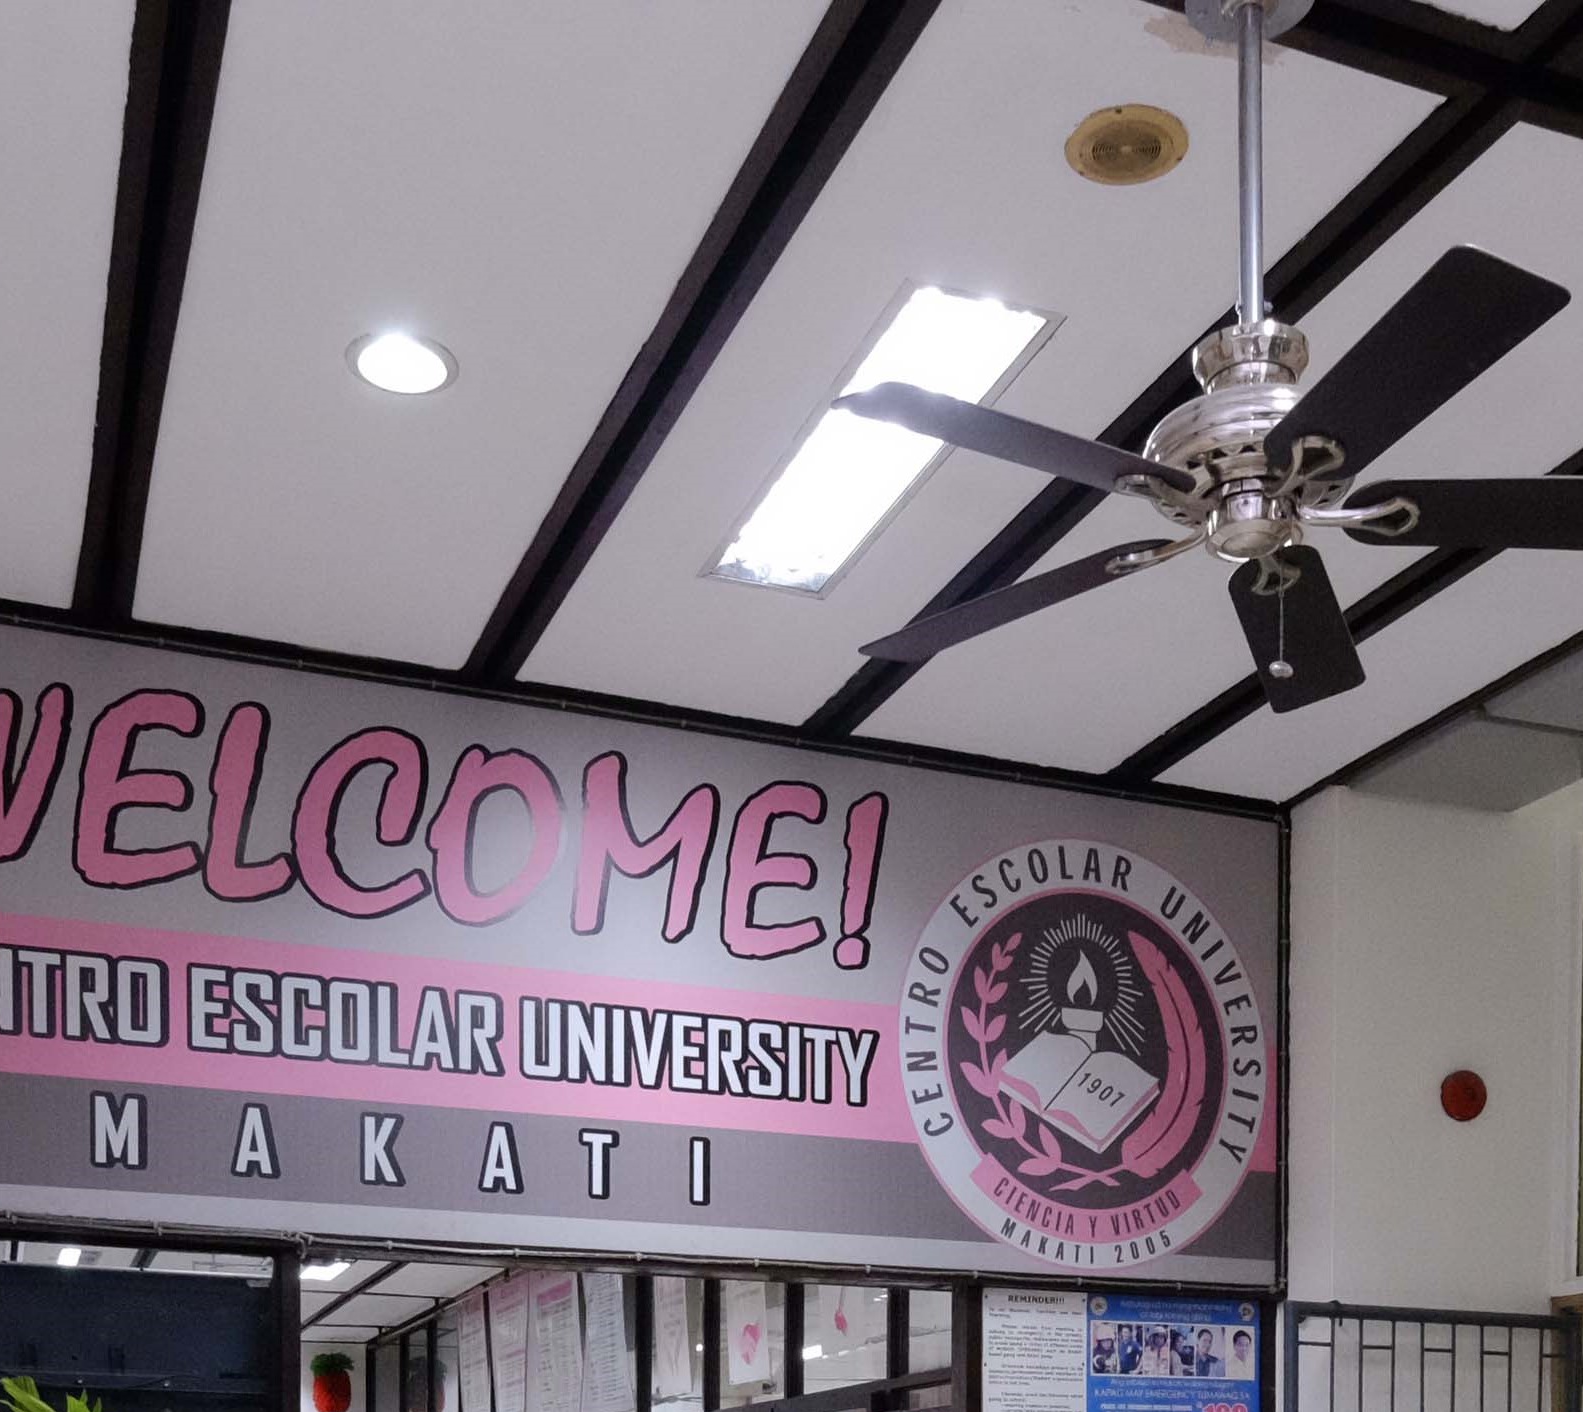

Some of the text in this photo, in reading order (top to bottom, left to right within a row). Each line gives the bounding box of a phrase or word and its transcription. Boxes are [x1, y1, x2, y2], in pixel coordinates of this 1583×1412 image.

[187, 962, 505, 1077] ESCOLAR
[518, 995, 880, 1107] UNIVERSITY
[904, 845, 1262, 1165] CENTRO ESCOLAR UNIVERSITY
[1076, 1072, 1126, 1108] 1907
[90, 1090, 711, 1206] MAKATI
[993, 1176, 1182, 1238] CIENCIA Y VIRTUD
[1000, 1217, 1171, 1264] MAKATI 2005
